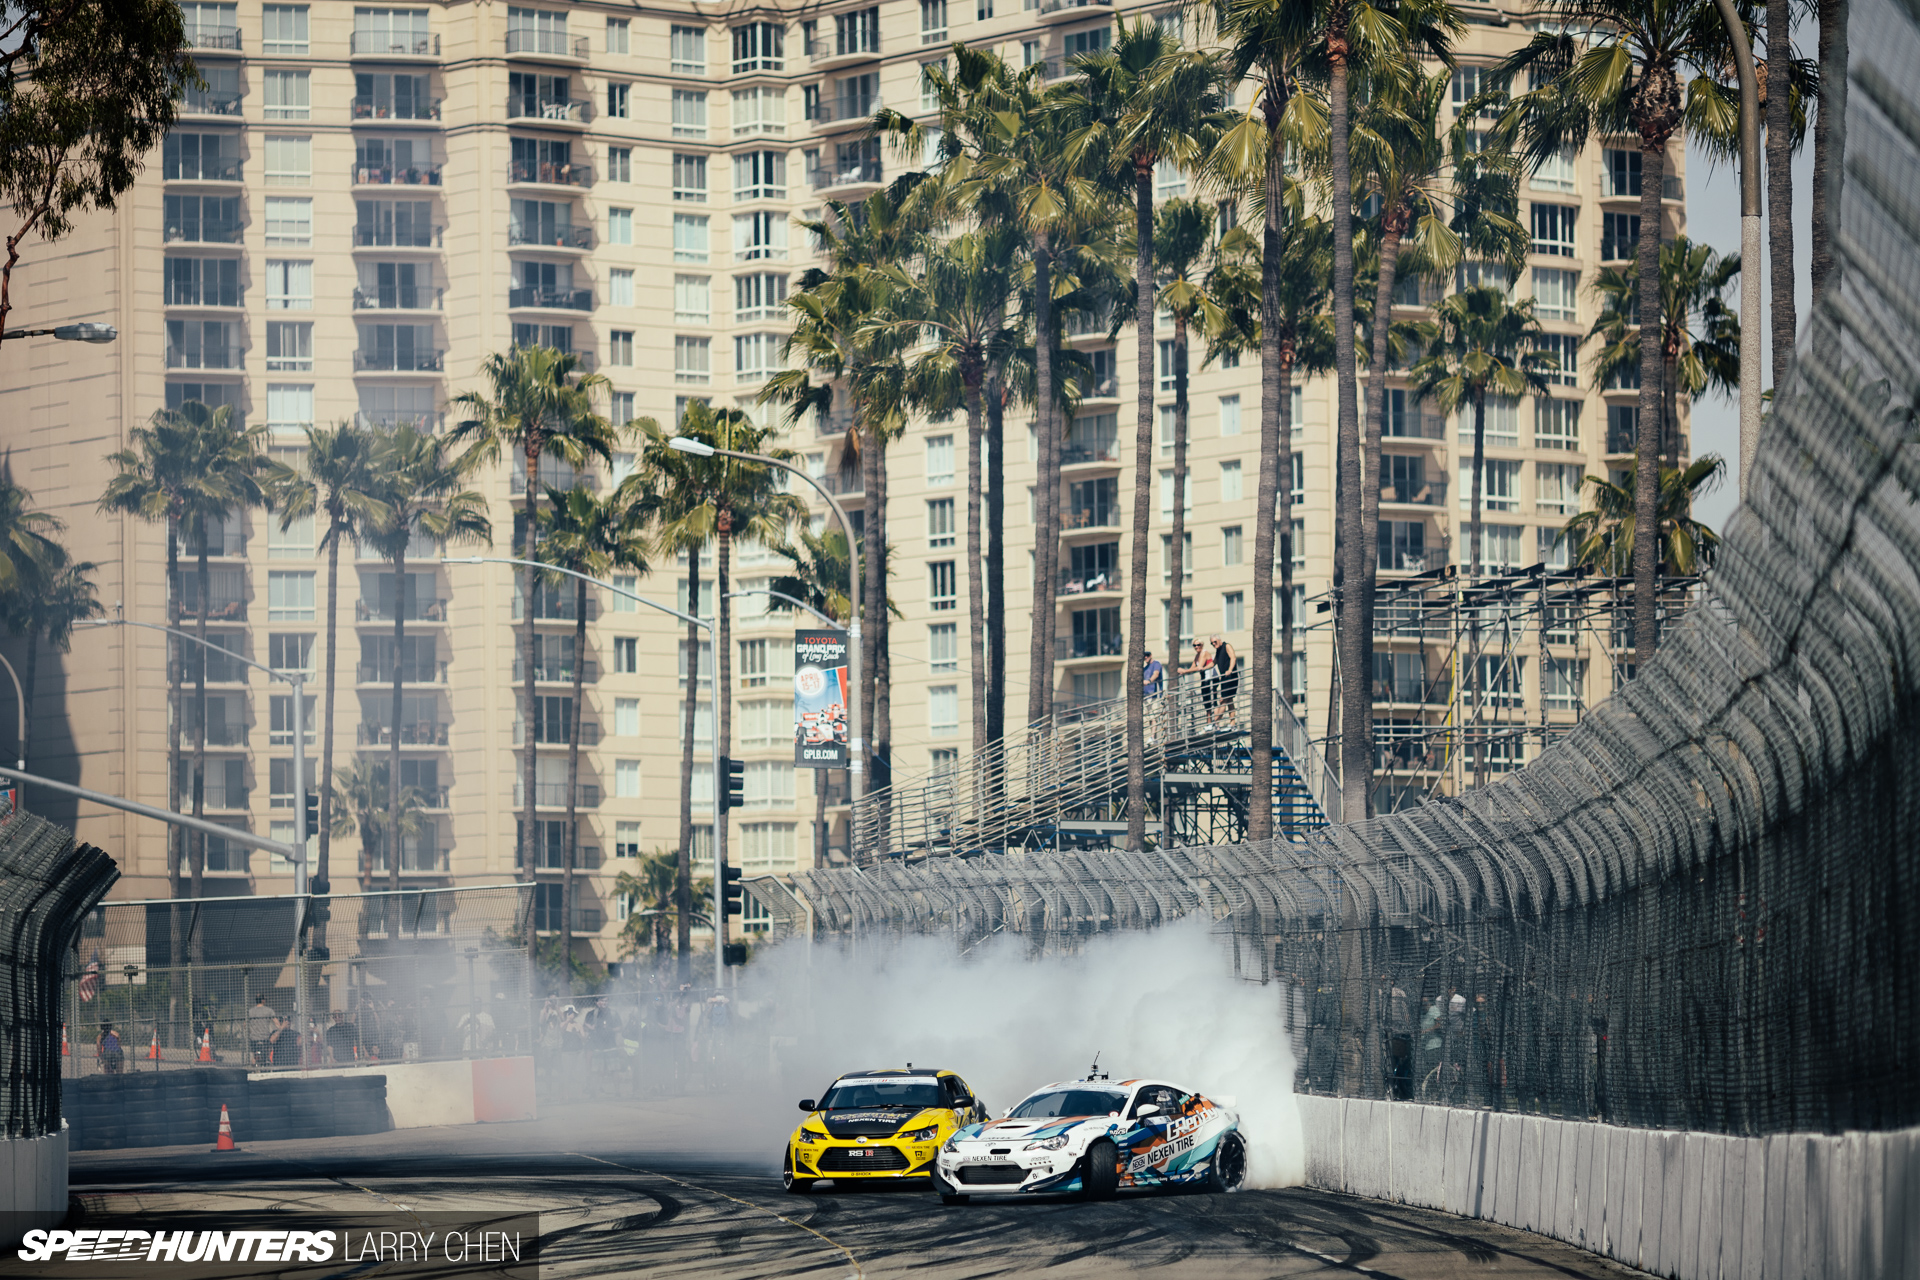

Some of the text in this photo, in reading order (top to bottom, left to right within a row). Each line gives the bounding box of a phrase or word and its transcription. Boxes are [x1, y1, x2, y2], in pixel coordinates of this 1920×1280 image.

[797, 644, 845, 653] GRAND PRIX
[803, 749, 838, 760] GPLB.COM
[1148, 1143, 1174, 1165] NEXEN
[1176, 1135, 1194, 1152] TIRE
